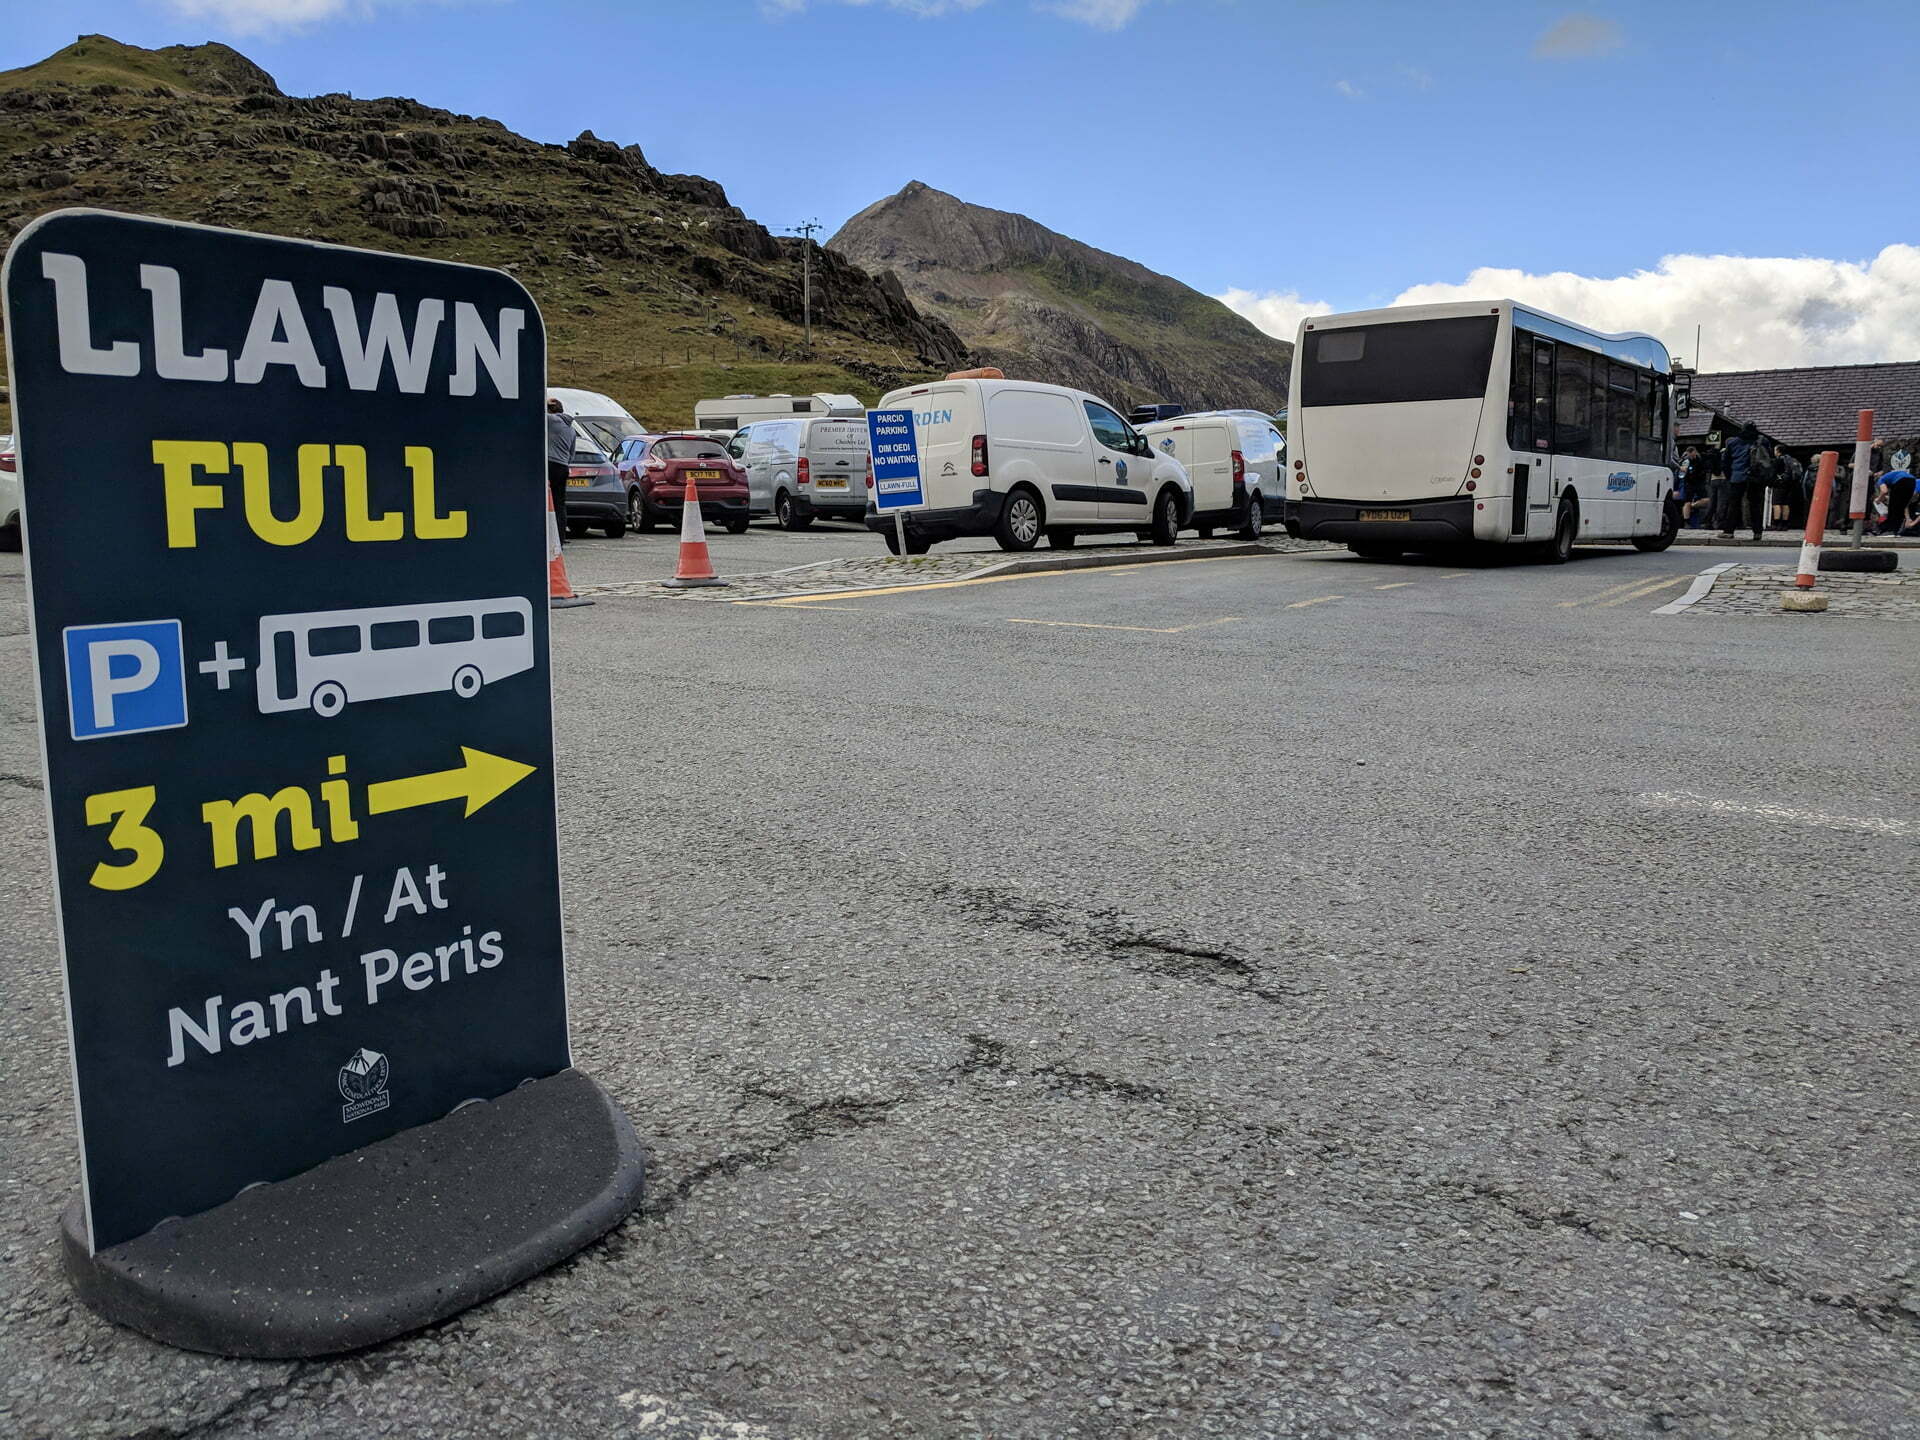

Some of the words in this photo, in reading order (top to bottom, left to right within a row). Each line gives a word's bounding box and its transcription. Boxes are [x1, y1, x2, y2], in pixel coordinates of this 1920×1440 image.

[41, 251, 525, 399] LLAWN
[876, 426, 908, 435] PARKING
[877, 414, 904, 423] PARCIO
[875, 457, 886, 465] NO
[886, 455, 917, 464] WAITING
[878, 444, 892, 453] DIM
[893, 443, 910, 452] OEDI
[152, 440, 467, 548] FULL
[880, 481, 917, 490] LLAWN-FULL
[88, 639, 160, 728] P
[85, 785, 164, 891] 3
[202, 755, 359, 869] mi
[228, 898, 323, 960] Yn
[342, 875, 364, 938] /
[384, 863, 449, 924] At
[167, 969, 342, 1067] Nant
[360, 926, 504, 1005] Peris
[345, 1095, 386, 1113] SNOWDONIA
